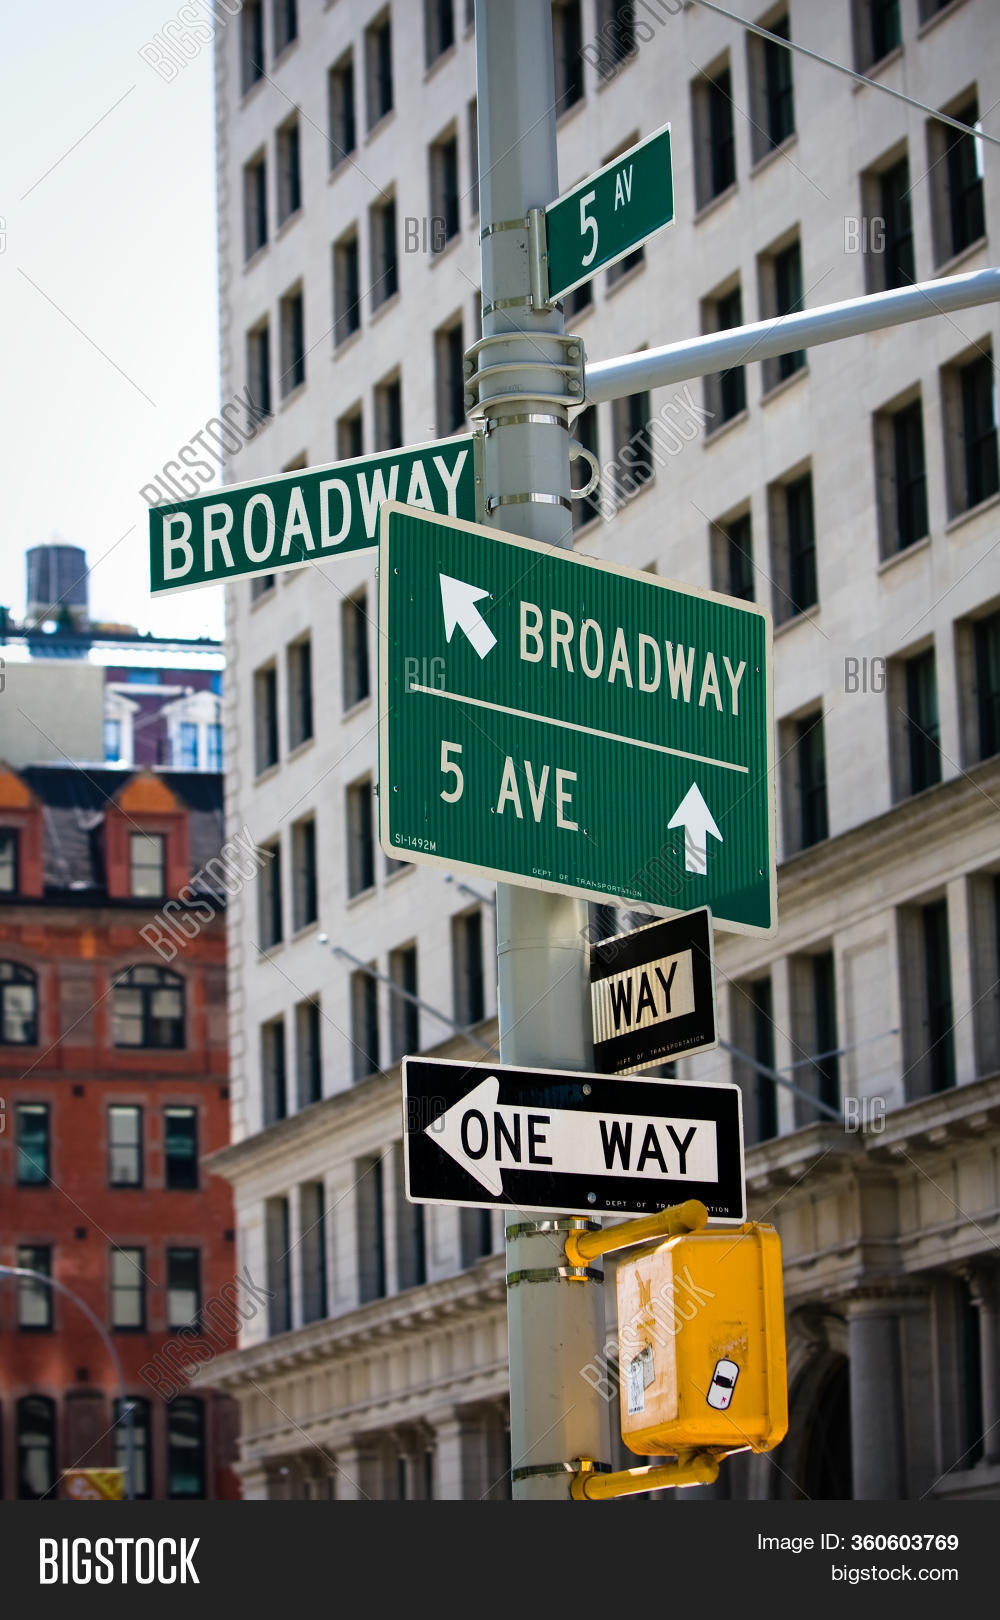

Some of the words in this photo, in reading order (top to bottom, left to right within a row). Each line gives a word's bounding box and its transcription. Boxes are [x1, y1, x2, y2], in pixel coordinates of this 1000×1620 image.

[579, 190, 598, 267] 5
[614, 164, 634, 211] AV
[162, 450, 468, 581] BROADWAY
[520, 600, 746, 716] BROADWAY
[440, 740, 464, 803] 5
[497, 756, 579, 831] AVE
[395, 833, 436, 851] SI-1492M
[532, 867, 552, 877] DEPT
[559, 873, 569, 881] OF
[576, 877, 642, 897] TRANSPORTATION
[609, 961, 678, 1031] WAY
[650, 1034, 705, 1055] TRANSPORTATION
[460, 1108, 553, 1166] ONE
[599, 1120, 697, 1175] WAY
[605, 1199, 627, 1207] DEPT
